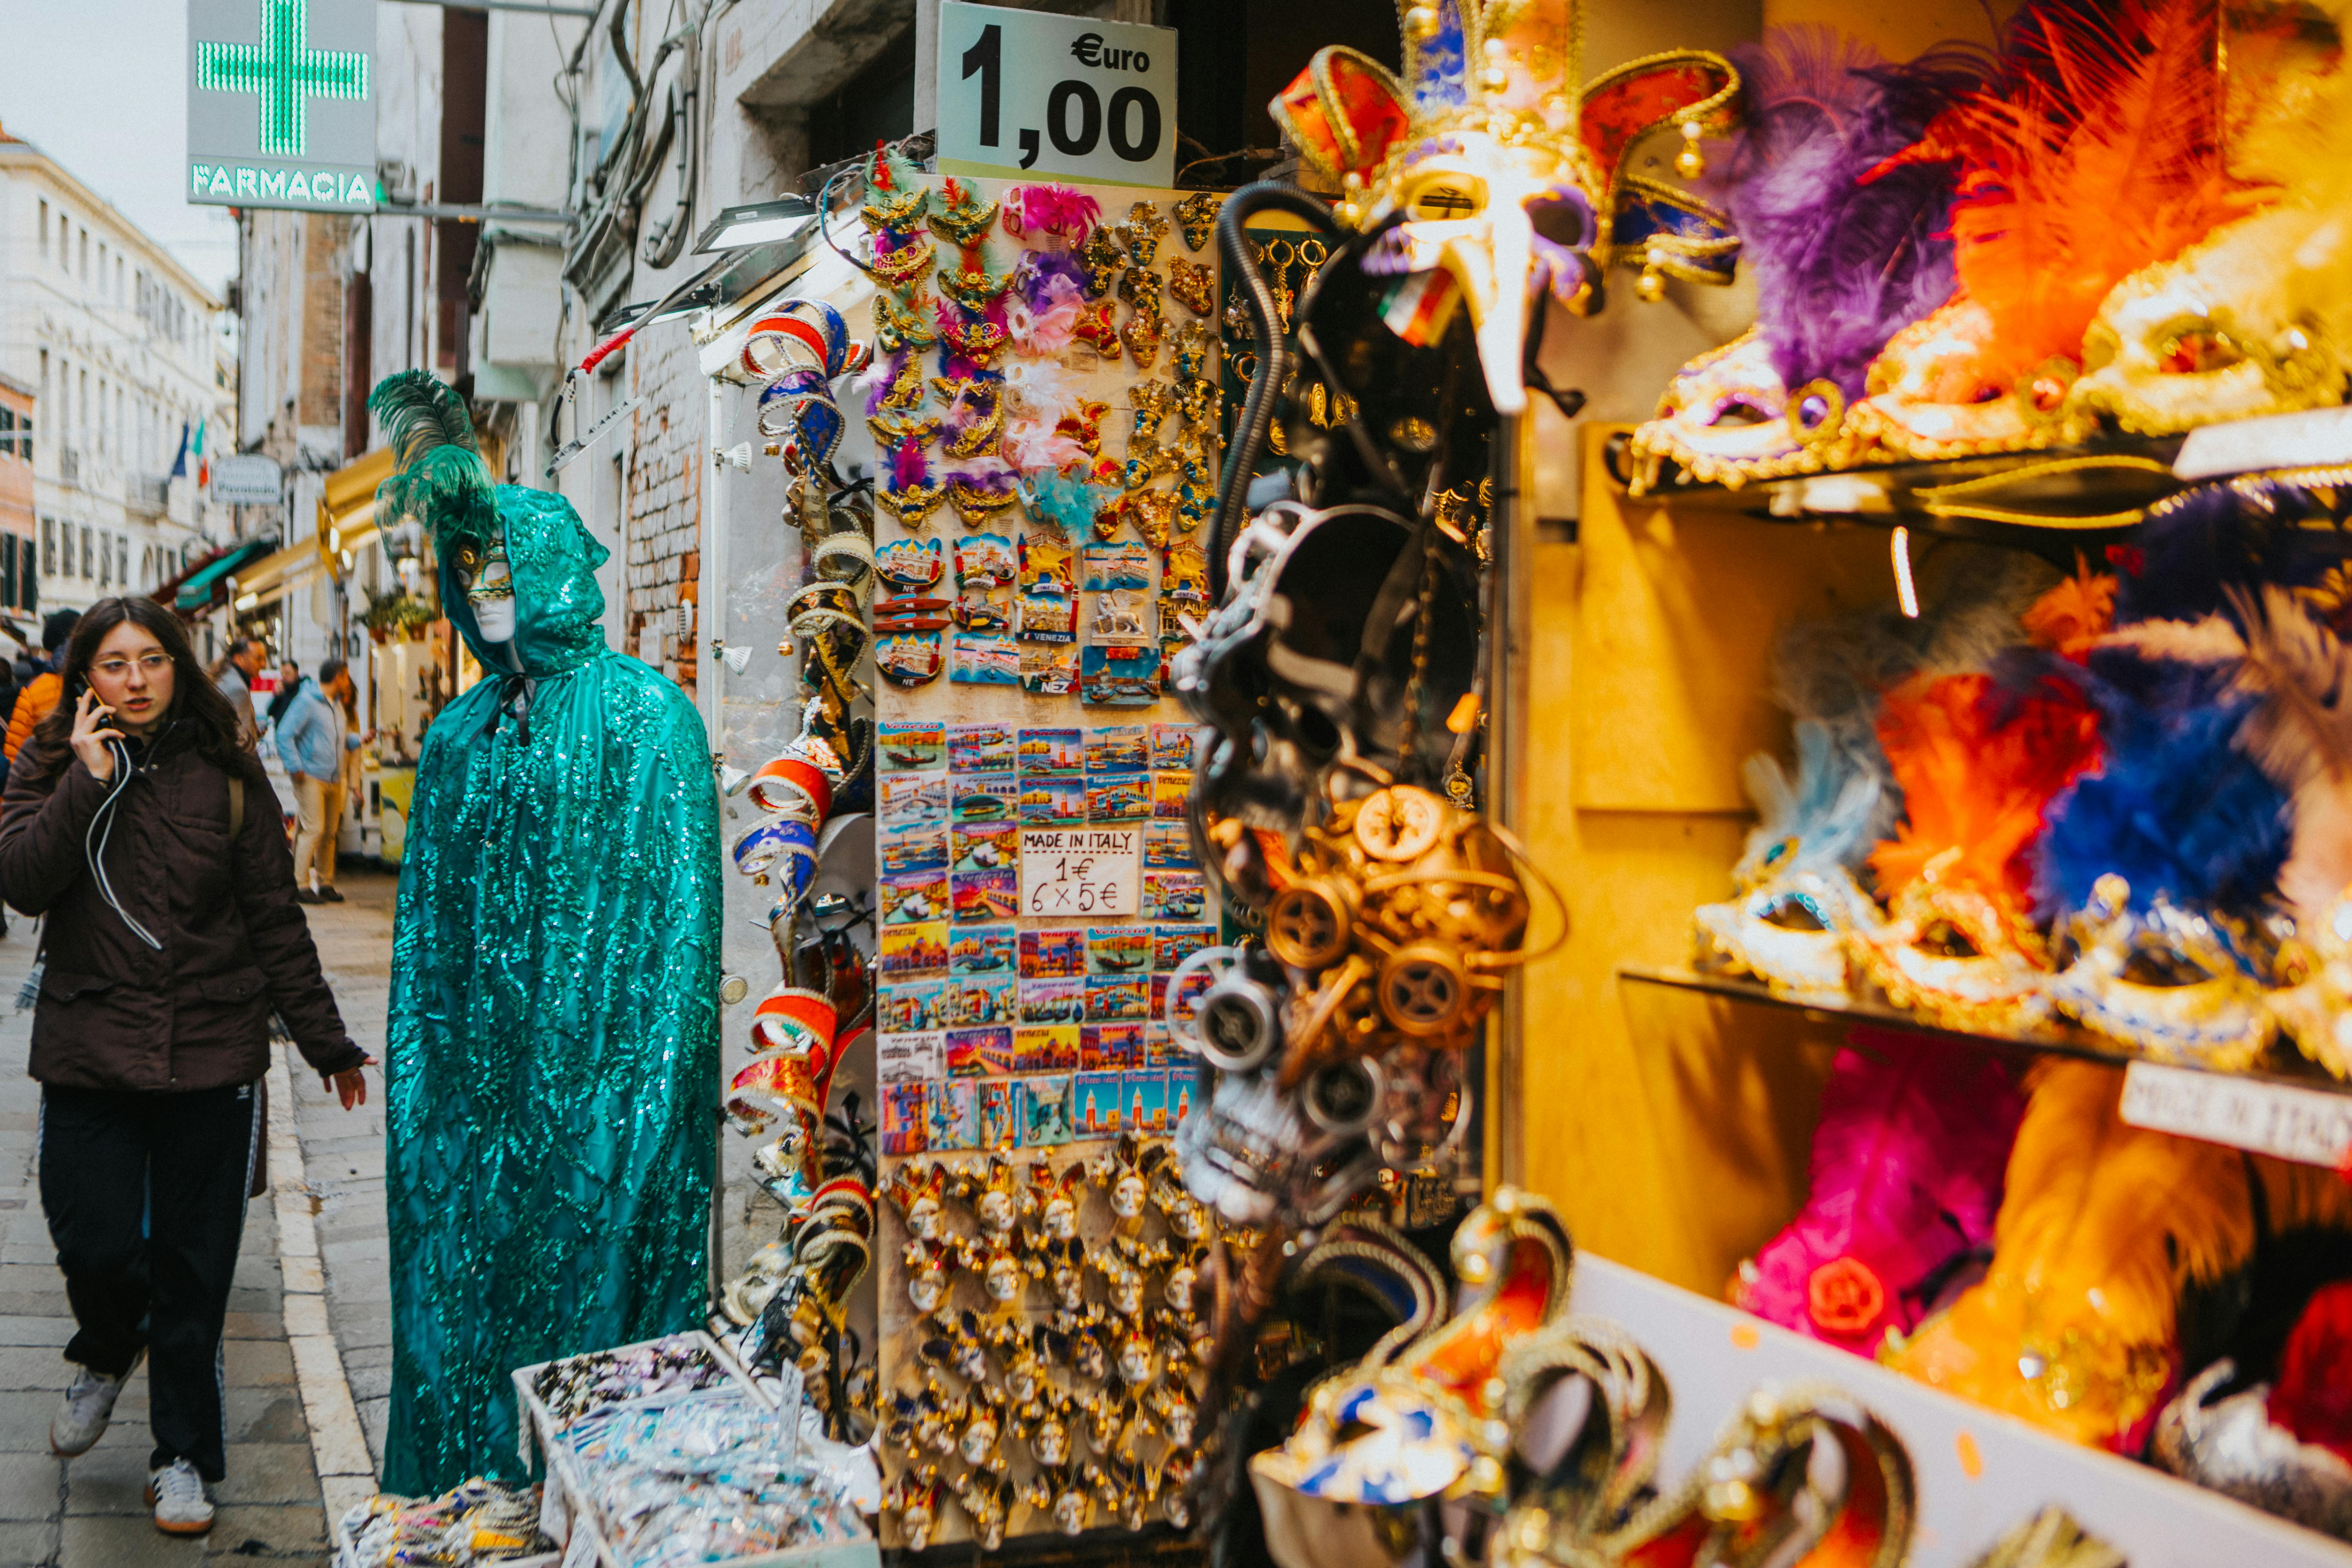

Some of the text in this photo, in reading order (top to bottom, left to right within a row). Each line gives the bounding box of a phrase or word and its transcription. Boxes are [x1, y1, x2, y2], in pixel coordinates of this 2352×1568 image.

[1071, 33, 1149, 72] €uro
[962, 24, 1161, 170] 1,00
[193, 165, 371, 205] FARMACIA
[1034, 633, 1071, 642] VENEZIA
[1024, 833, 1132, 850] MADE IN ITALY
[958, 871, 1013, 881] Venezia
[883, 928, 916, 937] venezia
